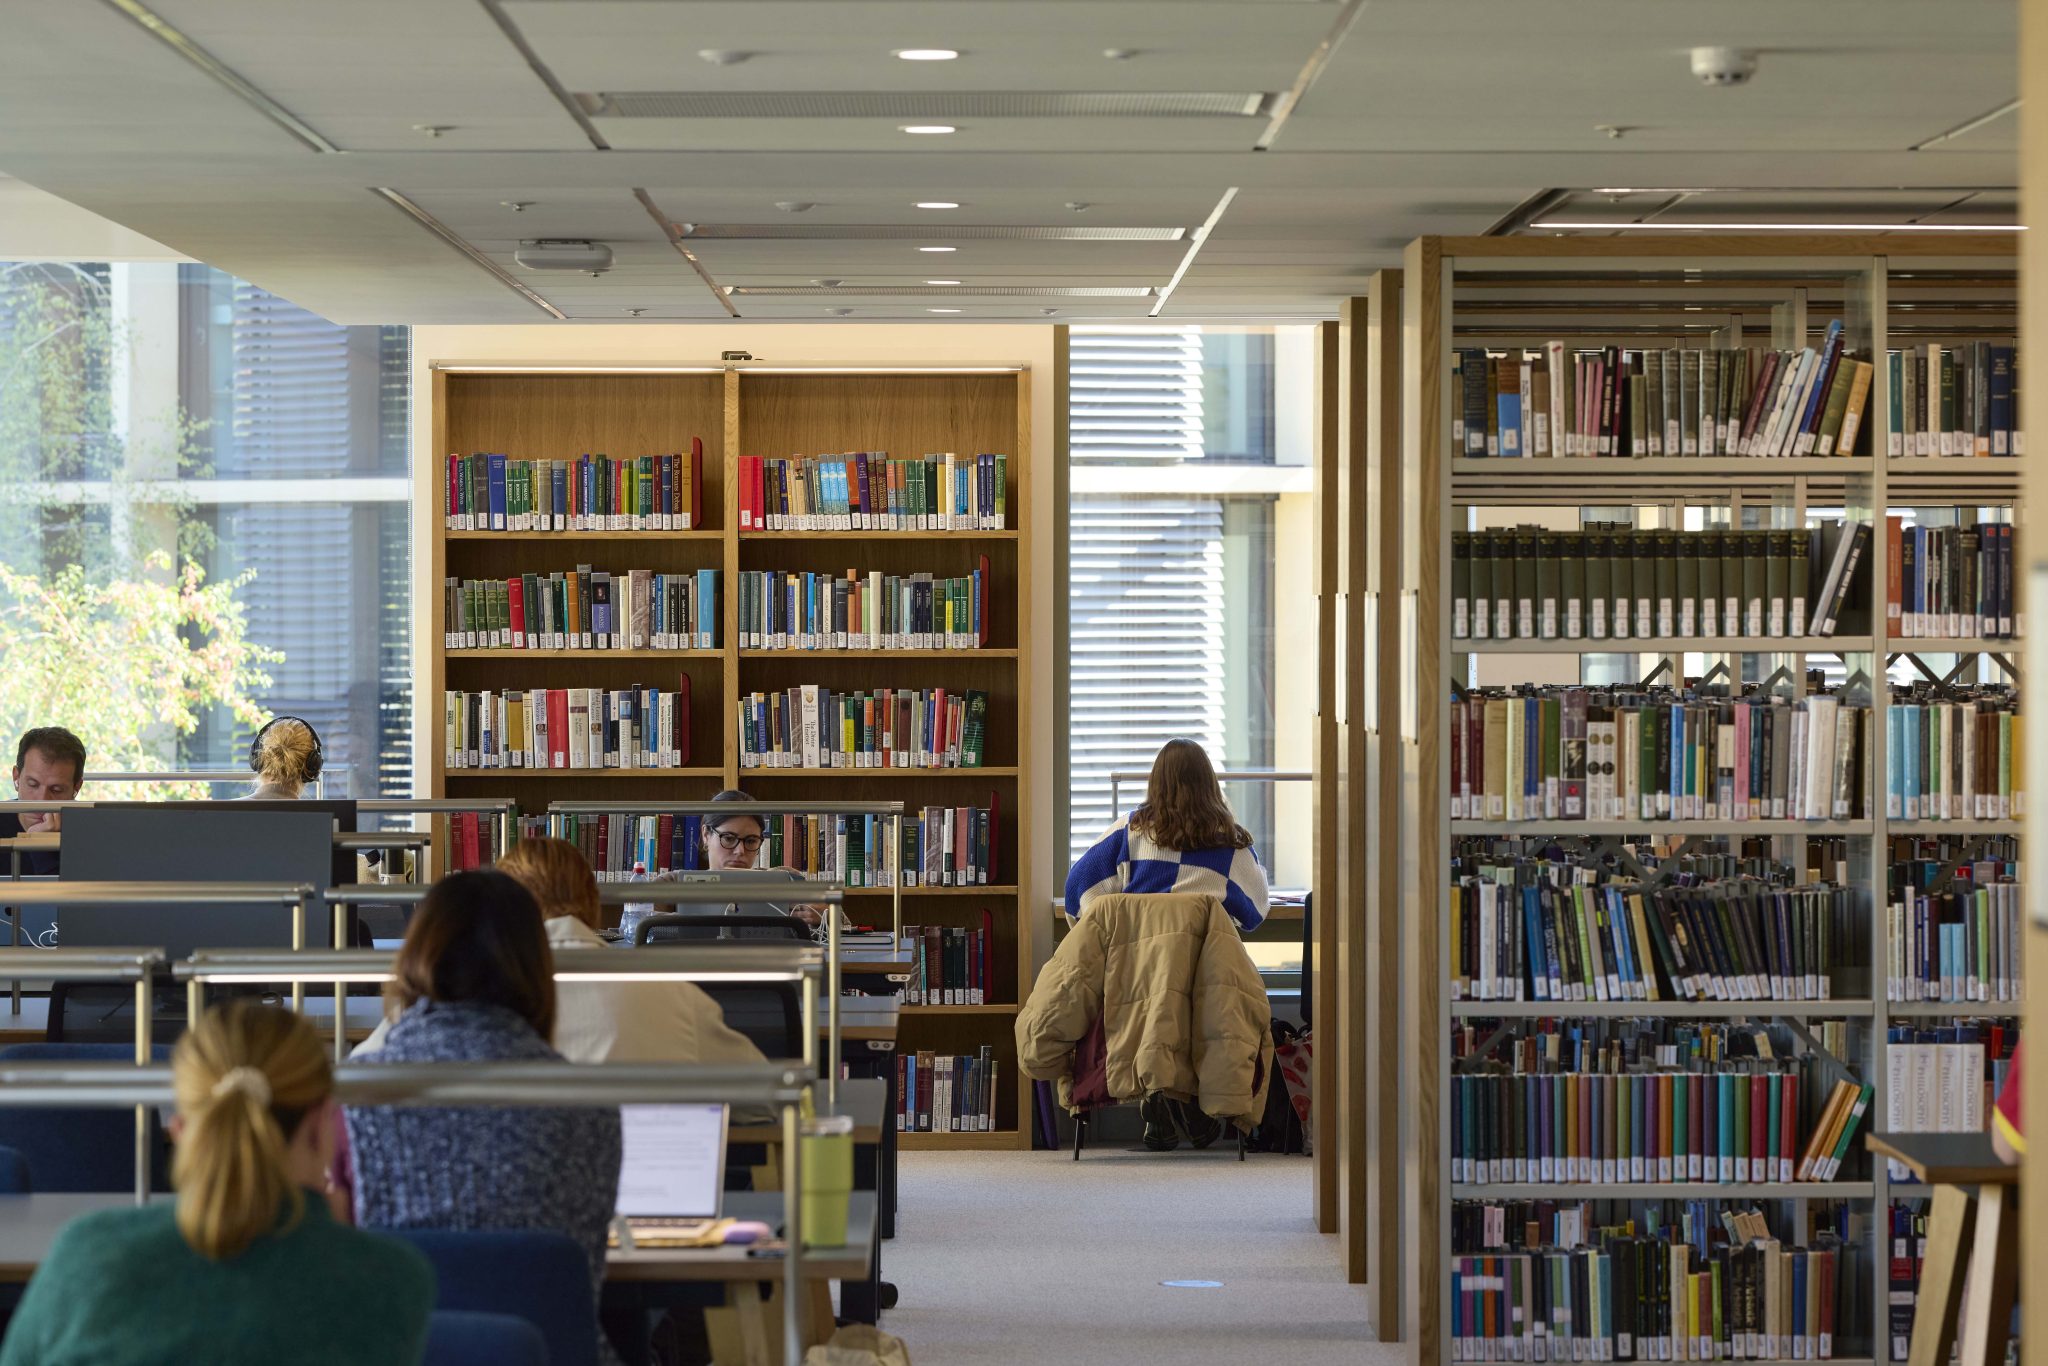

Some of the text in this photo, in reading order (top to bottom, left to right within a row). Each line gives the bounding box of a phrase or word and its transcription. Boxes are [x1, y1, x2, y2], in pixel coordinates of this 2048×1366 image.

[1893, 1068, 1902, 1126] PHILOSOPHY
[1917, 1067, 1926, 1125] PHILOSOPHY
[1942, 1067, 1951, 1124] PHILOSOPHY
[1966, 1069, 1976, 1126] PHILOSOPHY
